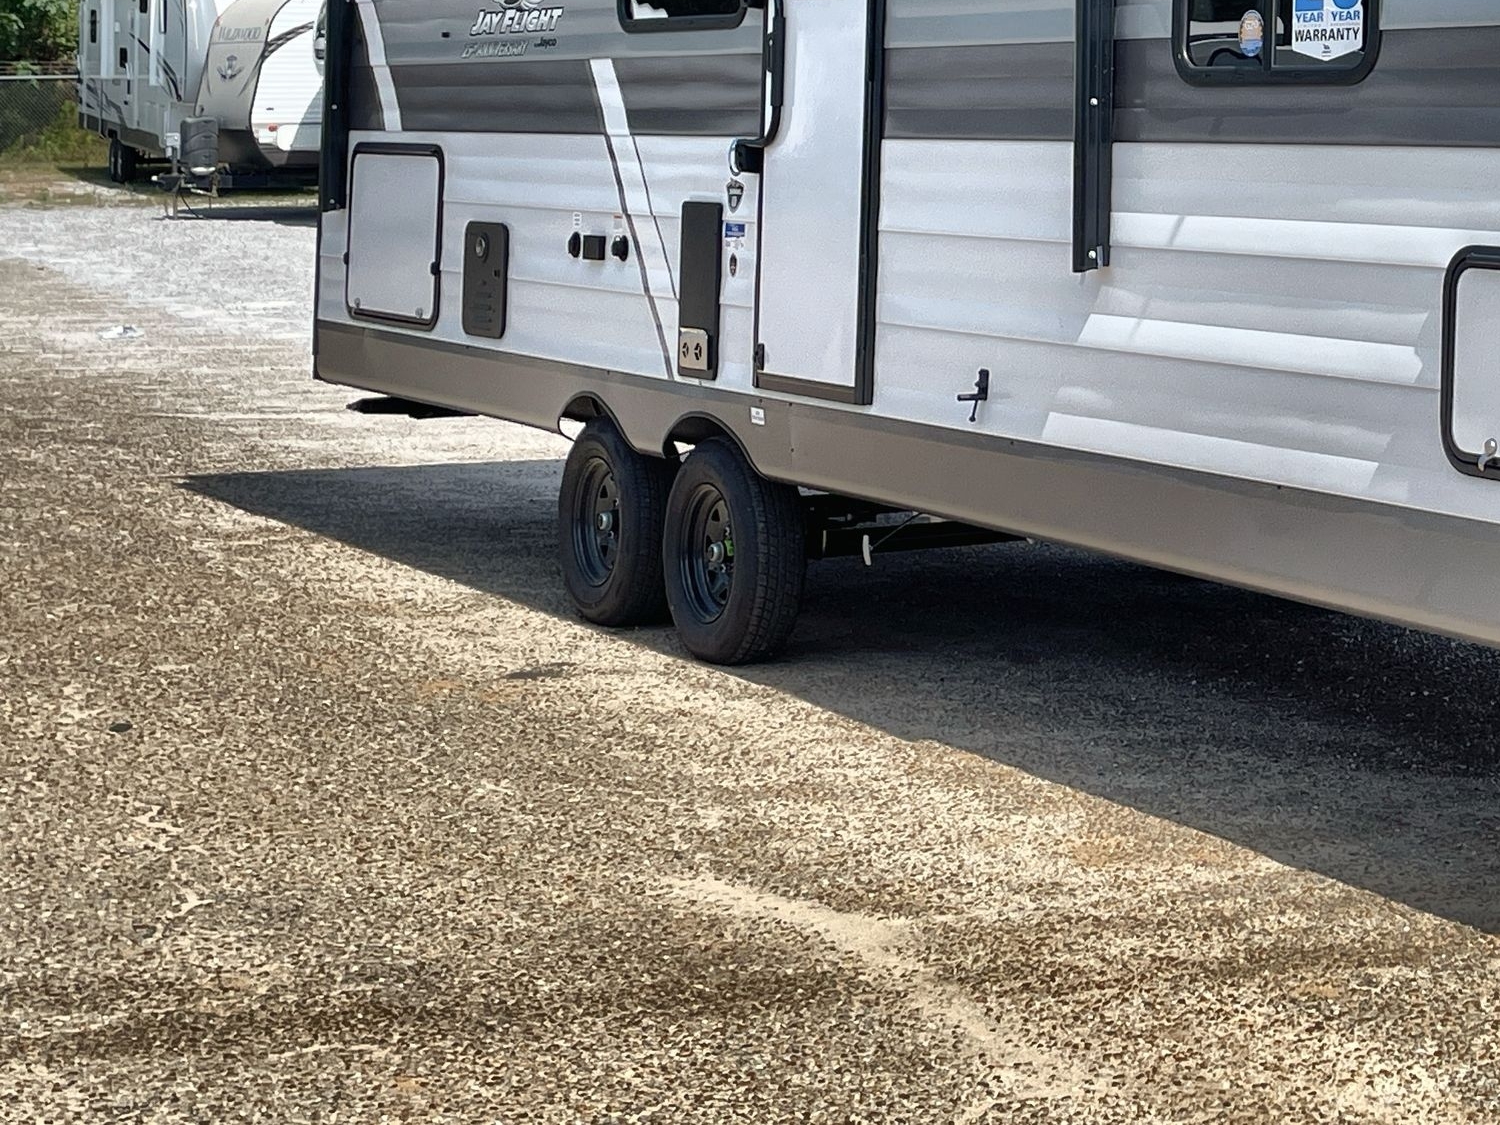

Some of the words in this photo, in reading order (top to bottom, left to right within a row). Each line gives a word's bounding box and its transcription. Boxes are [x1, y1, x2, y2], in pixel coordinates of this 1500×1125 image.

[470, 9, 503, 36] JAY
[500, 6, 564, 34] FLIGHT
[1295, 12, 1324, 23] YEAR
[1331, 10, 1360, 21] YEAR
[1295, 27, 1360, 42] WARRANTY
